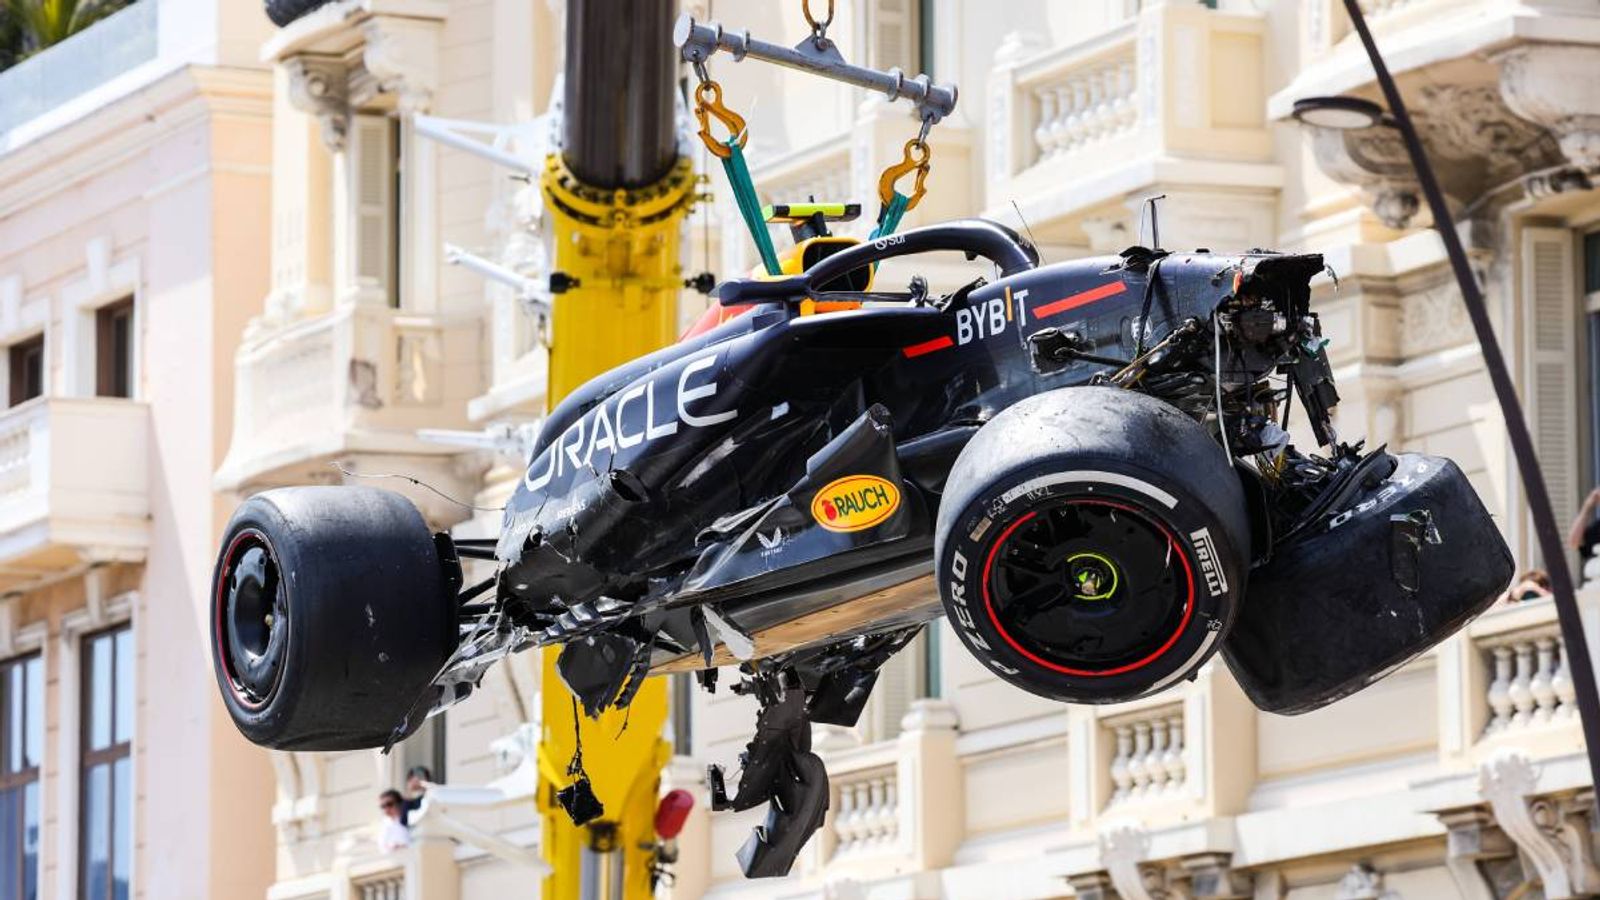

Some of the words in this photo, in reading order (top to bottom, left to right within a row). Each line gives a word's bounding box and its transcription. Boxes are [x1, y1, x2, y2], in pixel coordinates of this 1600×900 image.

[956, 286, 1029, 346] BYBIT
[525, 355, 738, 492] ORACLE
[833, 485, 889, 517] RAUCH
[1190, 527, 1228, 597] PIRELLI
[951, 550, 992, 651] ZERO
